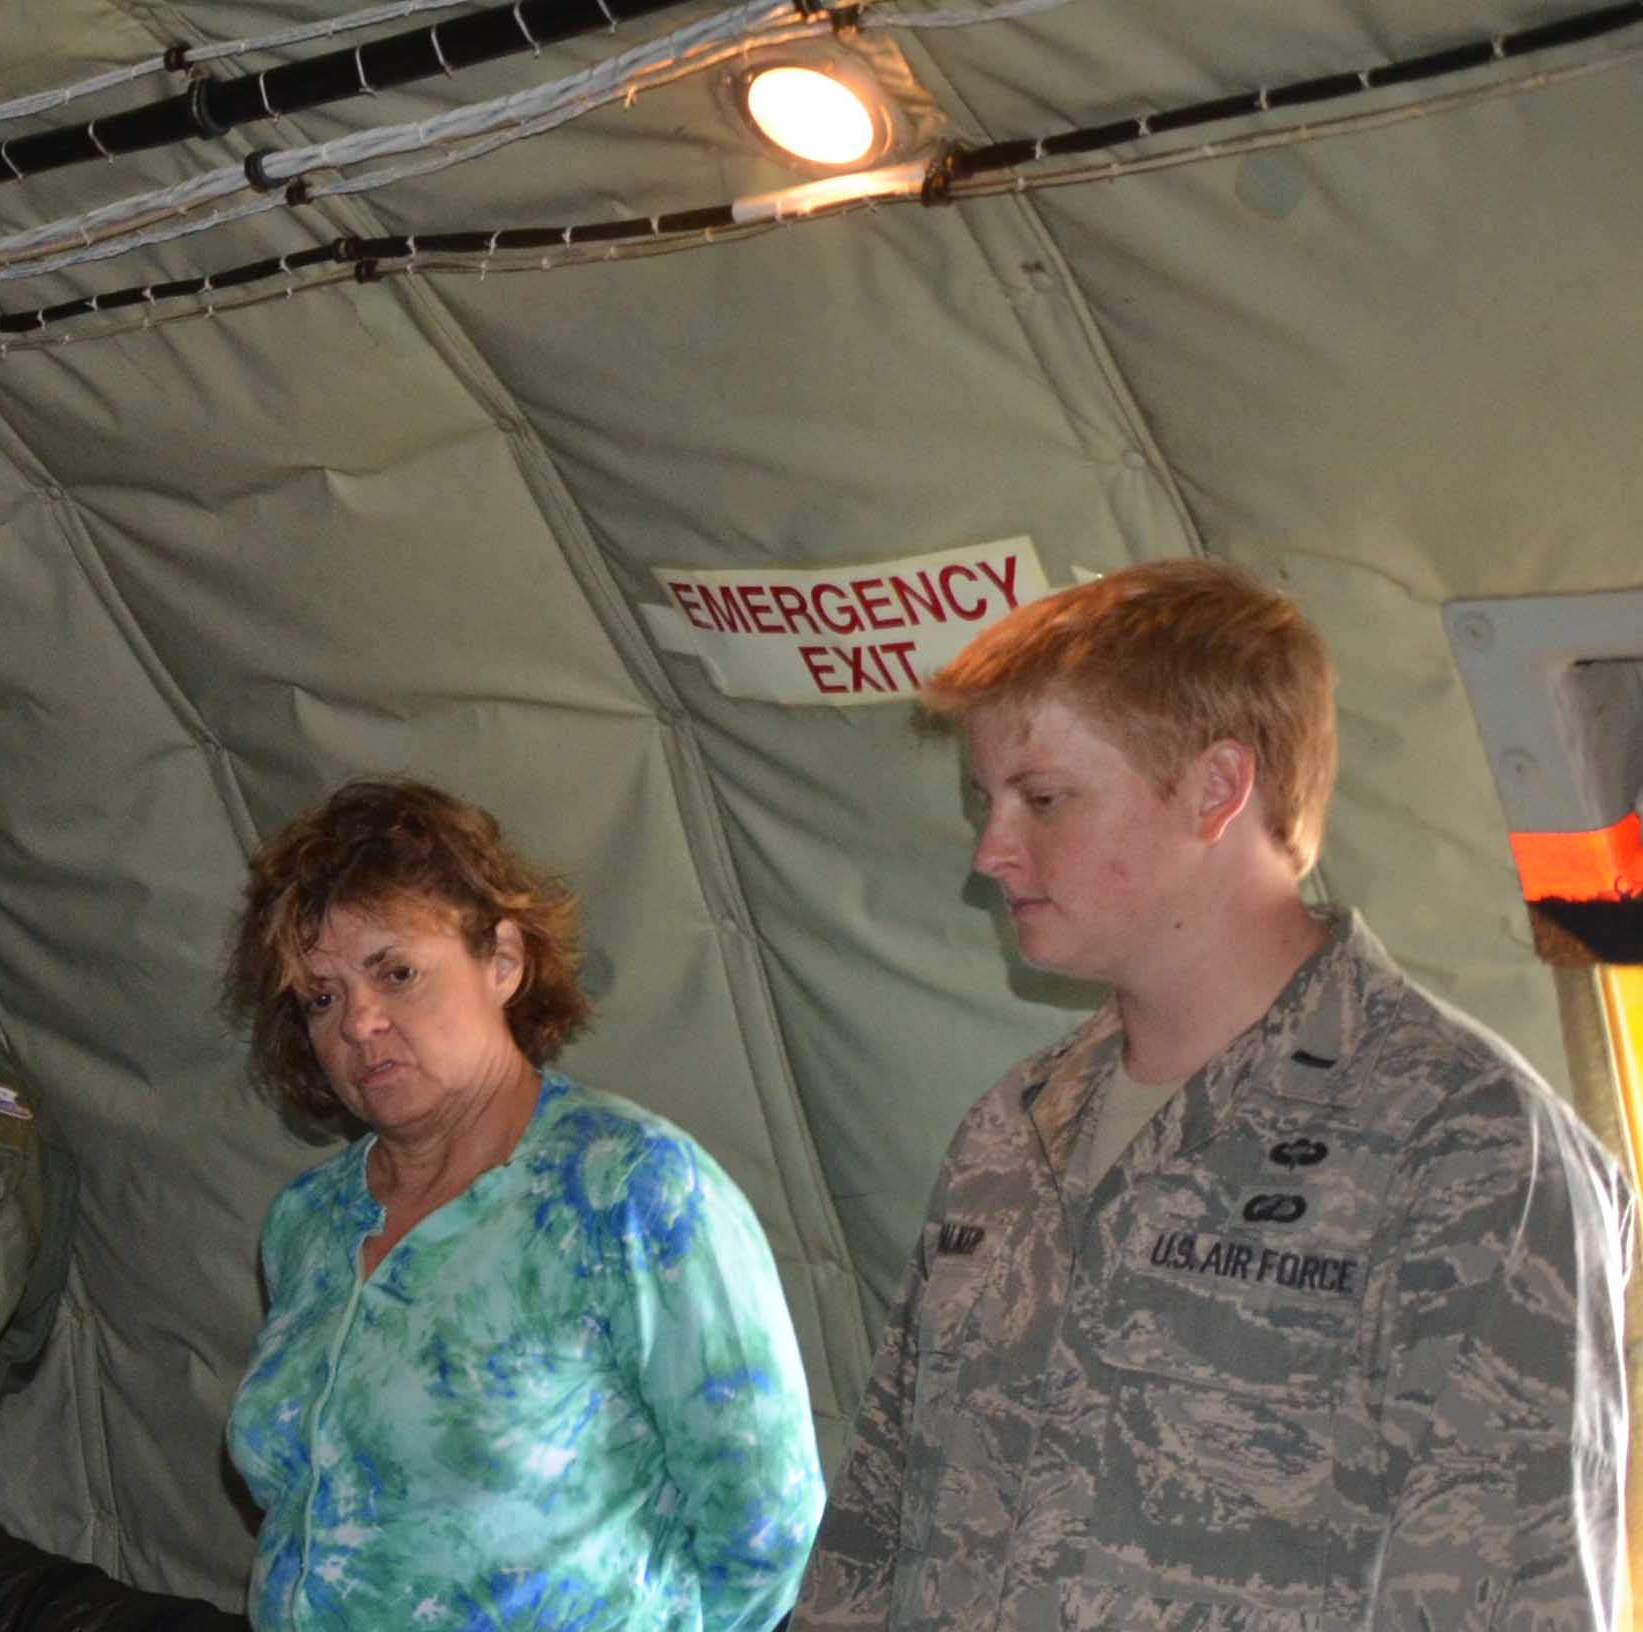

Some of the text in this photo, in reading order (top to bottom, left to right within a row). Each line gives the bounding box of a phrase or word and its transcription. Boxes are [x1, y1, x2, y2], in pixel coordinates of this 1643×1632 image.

[668, 554, 1020, 634] EMERGENCY
[798, 640, 920, 693] EXIT
[1149, 1232, 1358, 1293] U.S. AIR FORCE
